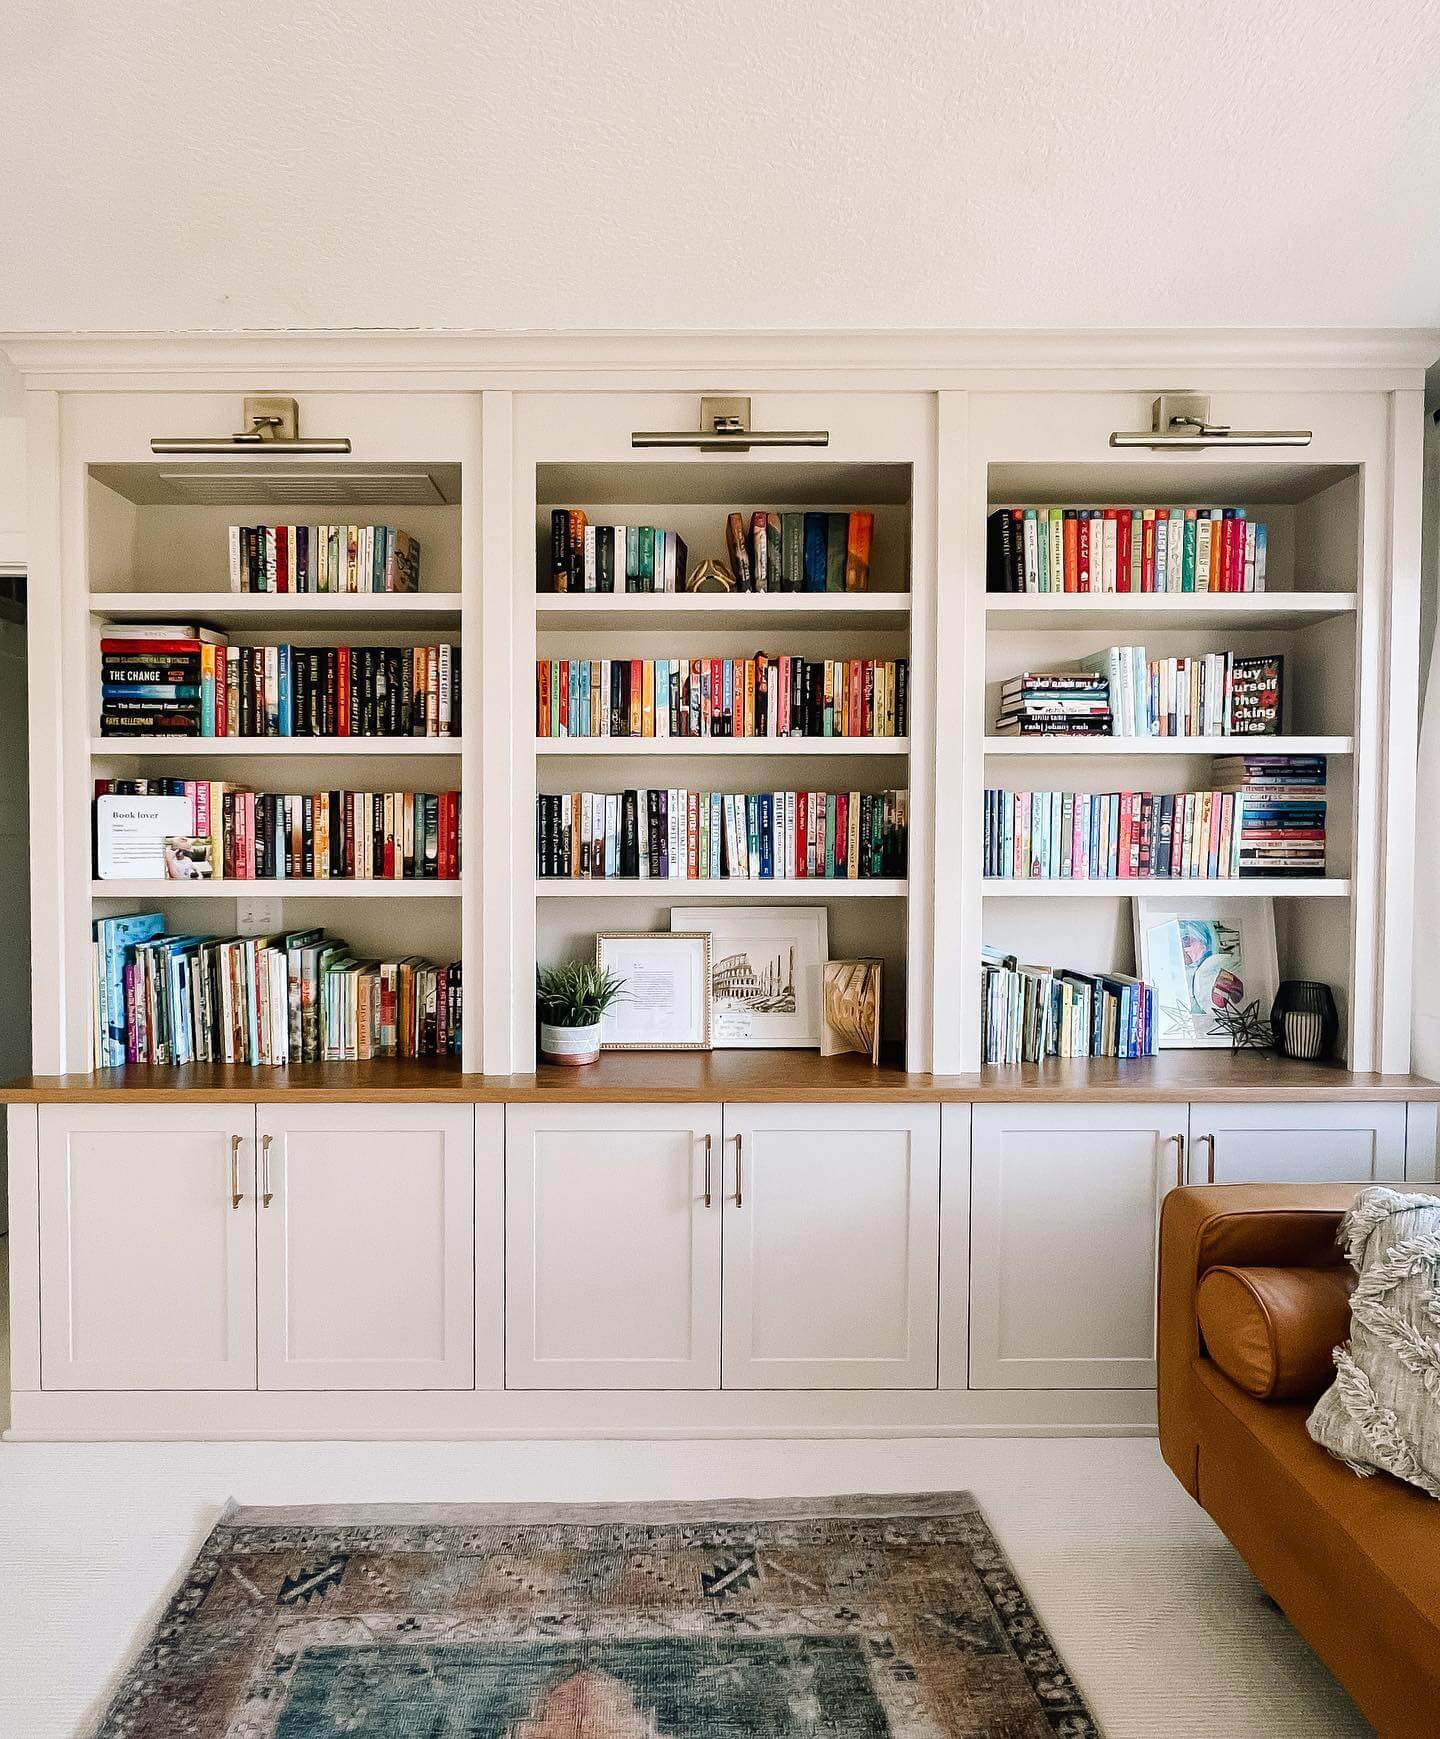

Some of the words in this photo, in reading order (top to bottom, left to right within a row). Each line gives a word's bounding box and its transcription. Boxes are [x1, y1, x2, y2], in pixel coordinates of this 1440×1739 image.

[1002, 514, 1010, 529] LISA
[1002, 531, 1010, 557] JEWELL
[110, 671, 125, 681] THE
[127, 671, 161, 681] CHANGE
[428, 660, 437, 691] HARLAN
[1233, 669, 1261, 680] Buy
[1232, 679, 1277, 692] urself
[1235, 695, 1259, 705] the
[105, 717, 119, 725] FAYE
[120, 717, 153, 725] KELLERMAN
[113, 811, 135, 819] Book
[137, 811, 159, 819] lover
